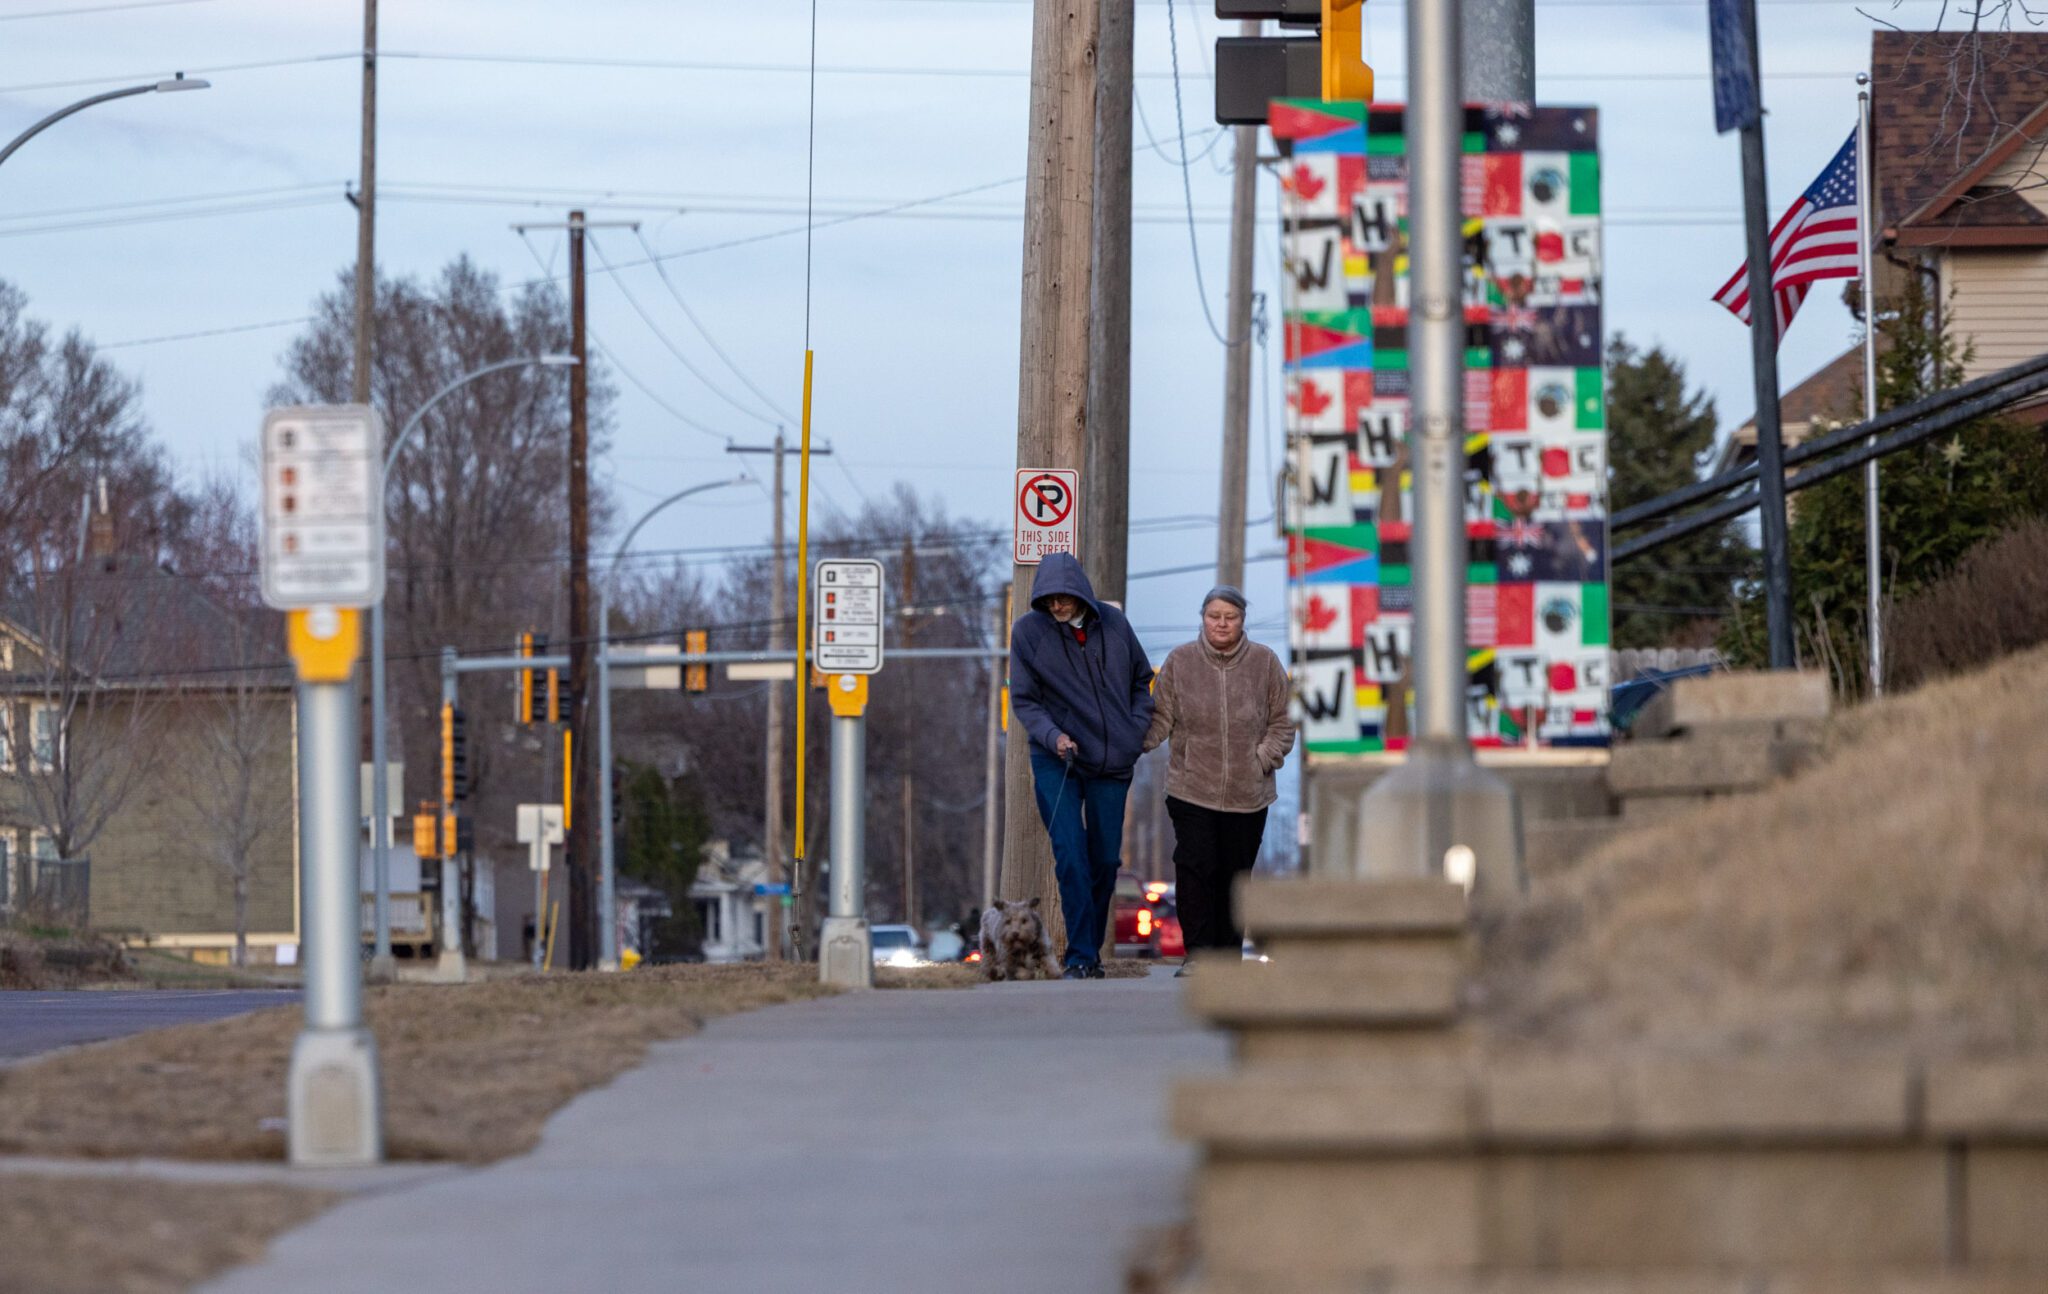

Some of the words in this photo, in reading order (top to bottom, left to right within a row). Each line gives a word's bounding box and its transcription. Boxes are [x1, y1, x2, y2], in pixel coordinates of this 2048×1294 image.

[1354, 200, 1386, 244] H
[1500, 227, 1526, 254] T
[1300, 239, 1333, 292] W
[1360, 415, 1392, 459] H
[1506, 441, 1532, 469] T
[1019, 543, 1031, 556] OF
[1037, 544, 1071, 556] STREET
[1021, 530, 1042, 543] THIS
[1048, 531, 1070, 543] SIDE
[1366, 630, 1399, 674] H
[1512, 657, 1538, 684] T
[1298, 669, 1345, 721] W
